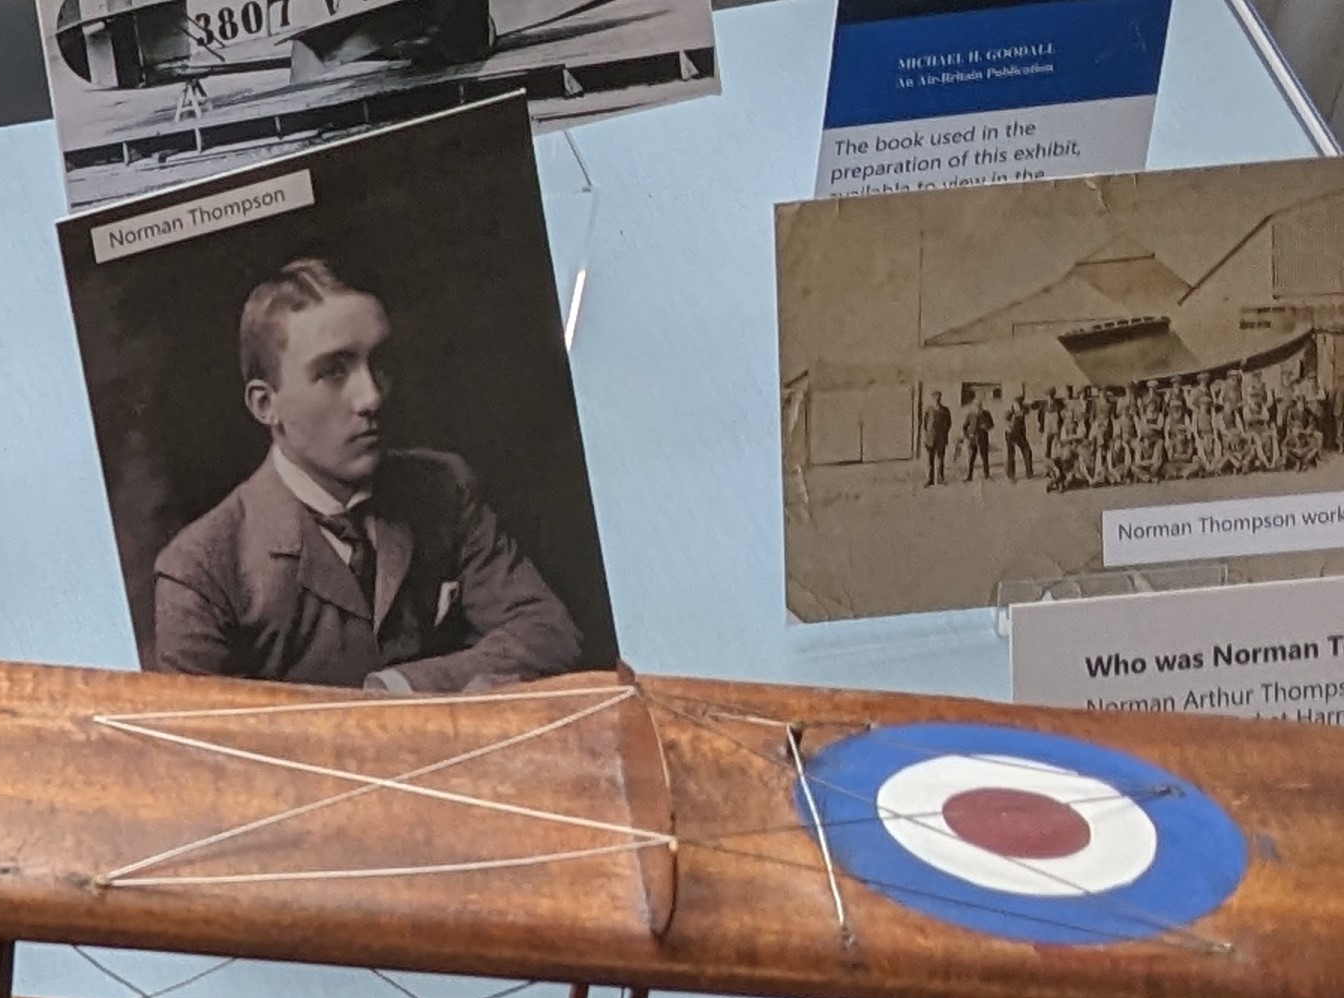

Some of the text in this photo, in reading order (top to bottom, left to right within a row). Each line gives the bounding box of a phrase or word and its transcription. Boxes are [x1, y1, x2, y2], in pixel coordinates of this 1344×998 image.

[195, 0, 290, 46] 3807
[834, 120, 1037, 156] The book used in the
[830, 139, 1081, 184] preparation of this exhibit,
[108, 188, 286, 249] Norman Thompson
[1117, 521, 1192, 541] Norman
[1198, 512, 1296, 535] Thompson
[1084, 654, 1147, 679] Who
[1153, 651, 1204, 673] was
[1212, 641, 1319, 668] Norman
[1182, 686, 1255, 711] Arthur
